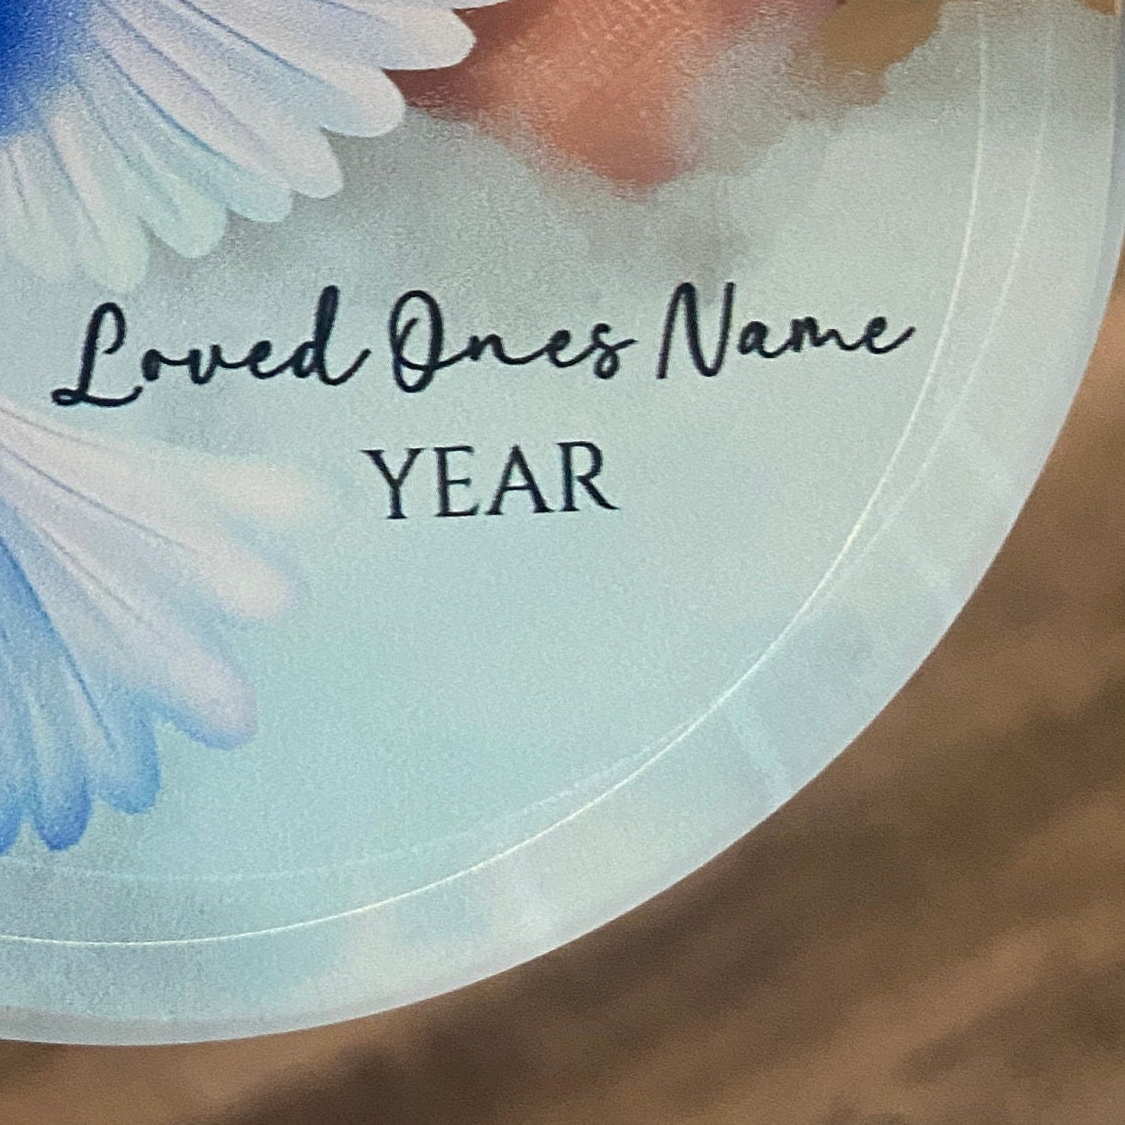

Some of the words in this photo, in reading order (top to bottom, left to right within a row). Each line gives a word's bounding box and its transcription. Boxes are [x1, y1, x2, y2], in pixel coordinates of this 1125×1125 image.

[51, 284, 373, 408] Loved
[388, 289, 638, 394] Ones
[656, 281, 917, 381] Name
[361, 440, 621, 520] YEAR
